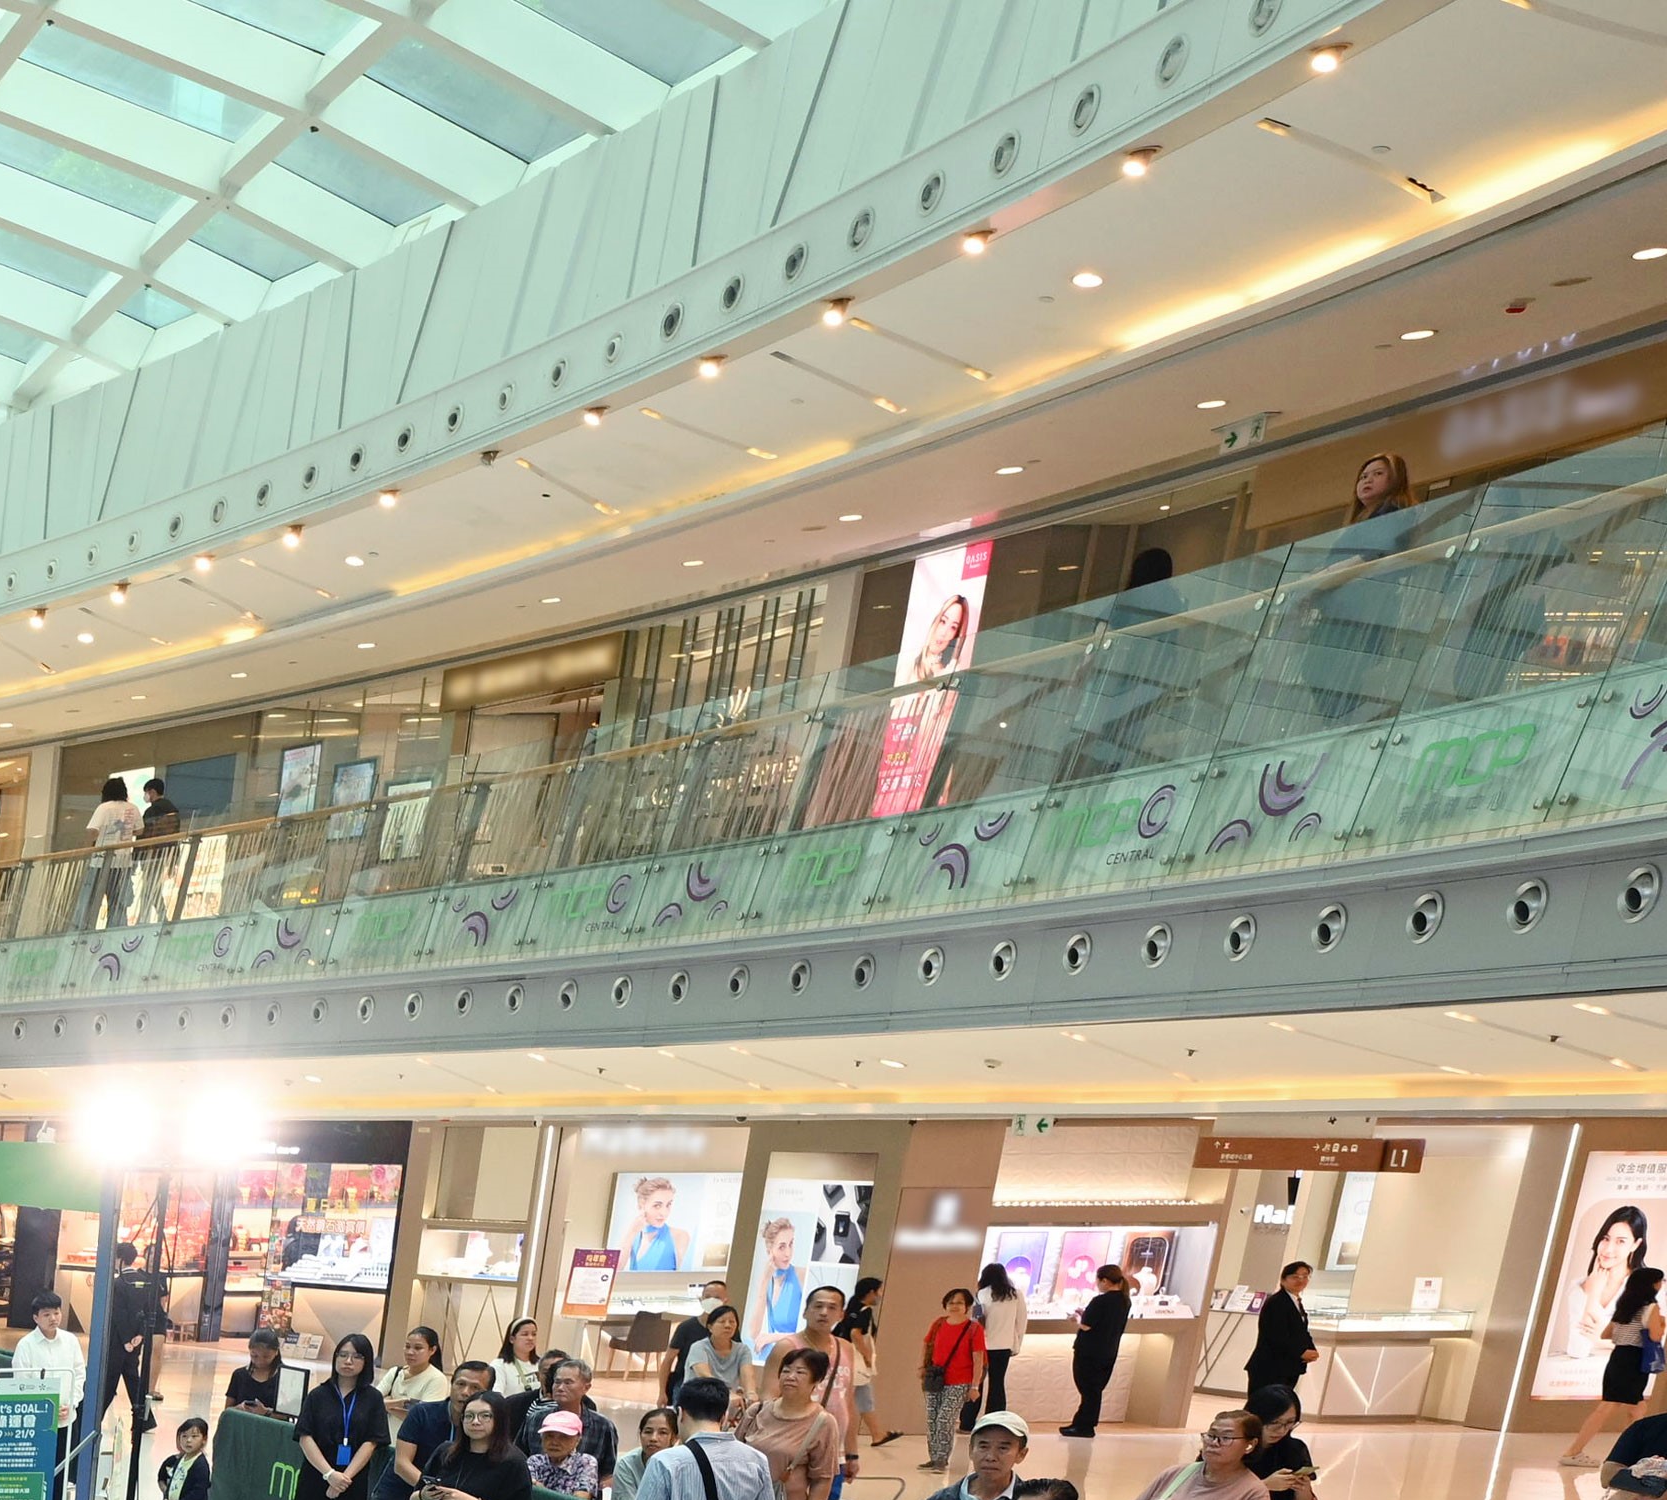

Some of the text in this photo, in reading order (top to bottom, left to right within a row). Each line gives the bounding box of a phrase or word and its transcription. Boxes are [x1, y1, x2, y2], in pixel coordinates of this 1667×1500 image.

[966, 552, 988, 565] OASIS
[1106, 848, 1155, 866] CENTRAL
[1389, 1148, 1409, 1169] L1
[14, 1429, 35, 1439] 21/9
